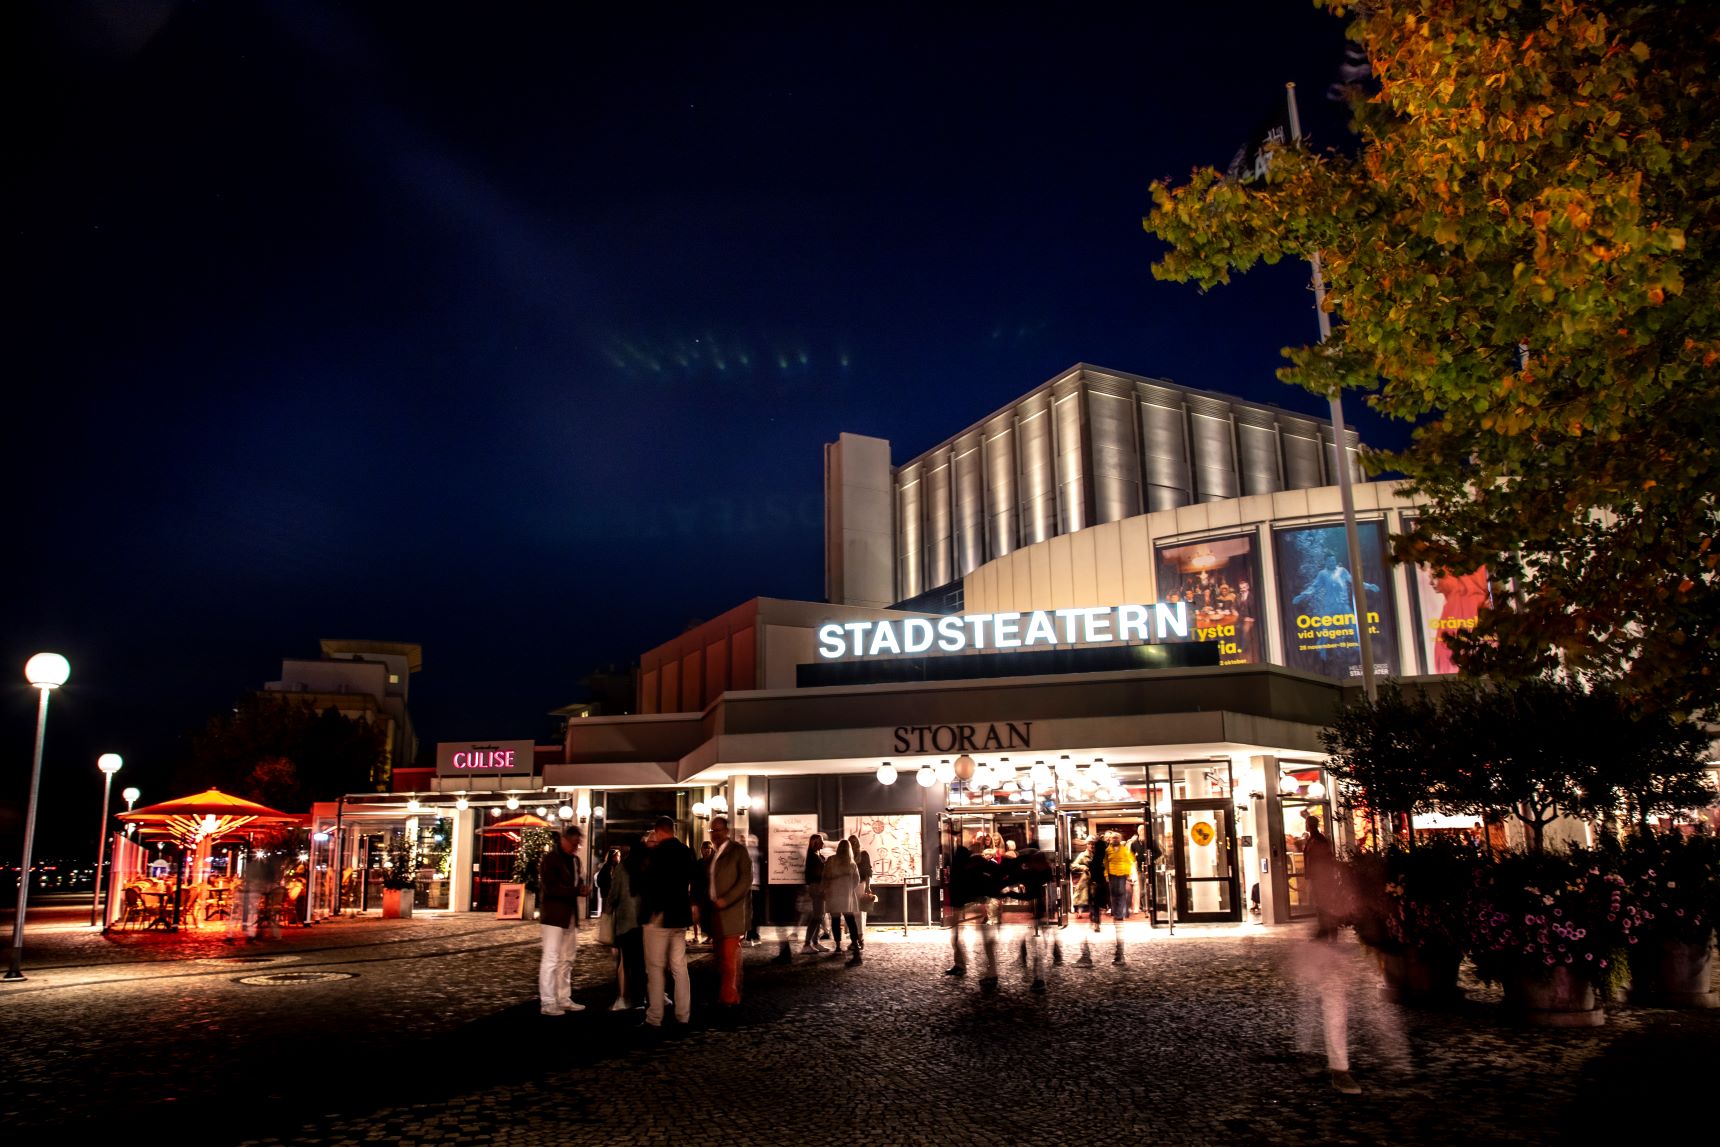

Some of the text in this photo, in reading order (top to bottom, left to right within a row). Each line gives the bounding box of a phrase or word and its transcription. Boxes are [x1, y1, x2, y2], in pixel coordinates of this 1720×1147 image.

[1297, 612, 1380, 628] Oceann
[819, 602, 1187, 658] STADSTEATERN
[1298, 630, 1314, 639] vid
[1316, 629, 1354, 639] vägens
[894, 722, 1032, 753] STORAN
[452, 751, 515, 769] CULISE
